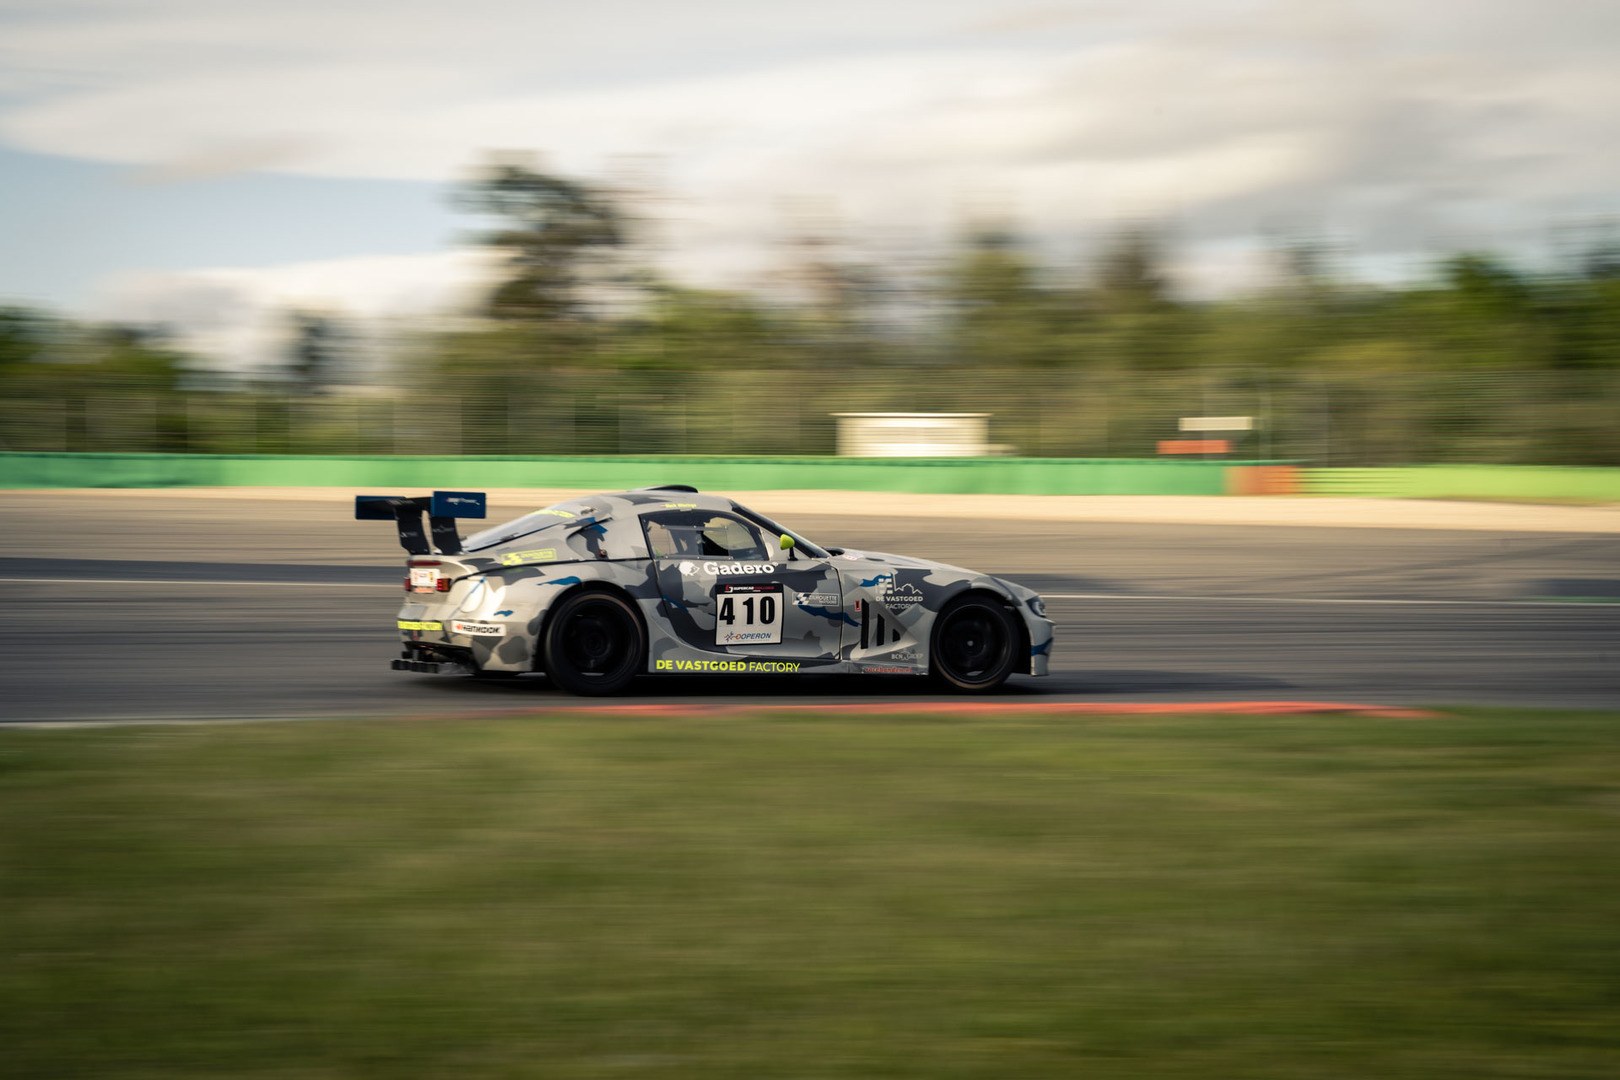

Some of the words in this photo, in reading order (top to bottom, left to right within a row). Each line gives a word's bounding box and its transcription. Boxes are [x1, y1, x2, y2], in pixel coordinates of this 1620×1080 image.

[703, 561, 775, 575] Gadero
[719, 596, 775, 625] 410
[656, 660, 674, 670] DE
[675, 660, 747, 672] VASTGOED
[748, 662, 801, 673] FACTORY
